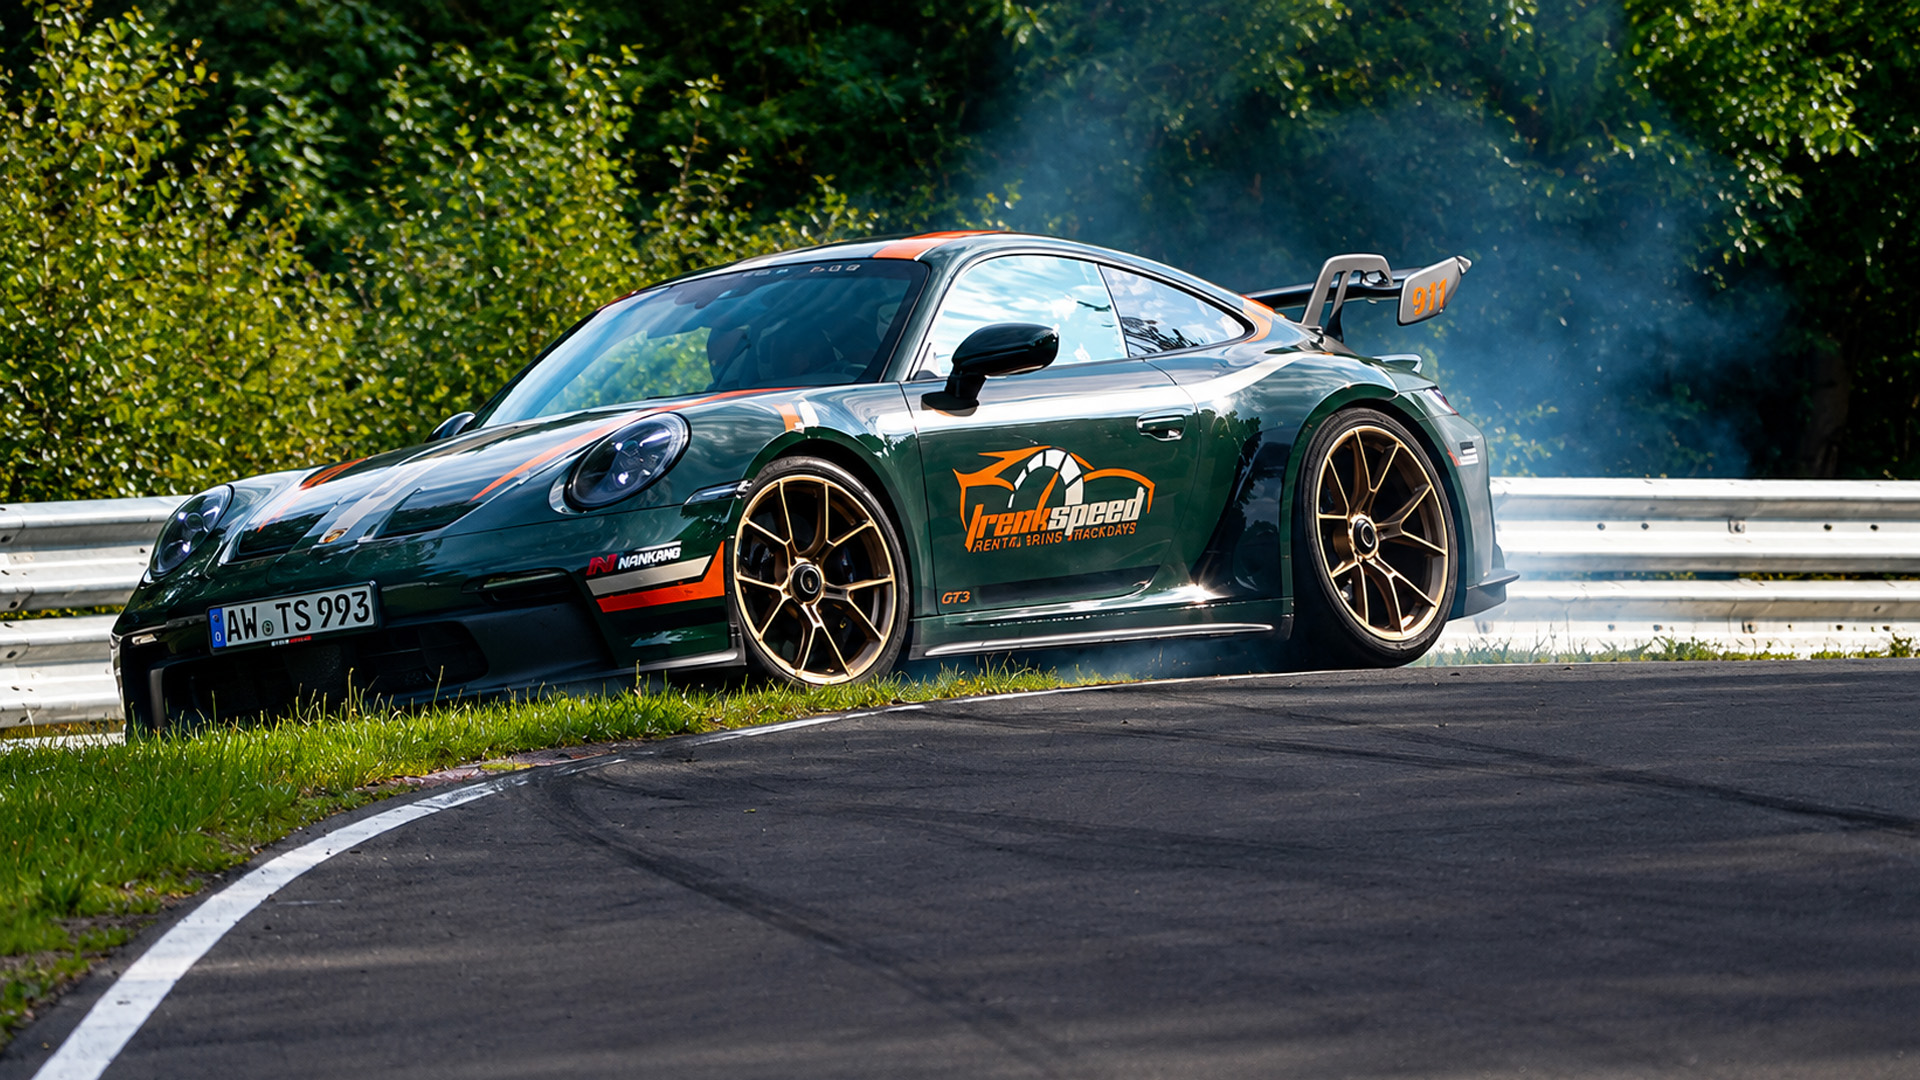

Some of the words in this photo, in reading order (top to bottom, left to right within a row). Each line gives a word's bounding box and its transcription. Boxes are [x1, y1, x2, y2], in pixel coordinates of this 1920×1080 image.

[1412, 278, 1447, 316] 911
[618, 547, 681, 570] NANKANG
[941, 591, 970, 604] GT3
[227, 606, 258, 643] AW
[275, 600, 312, 634] TS
[317, 590, 370, 629] 993
